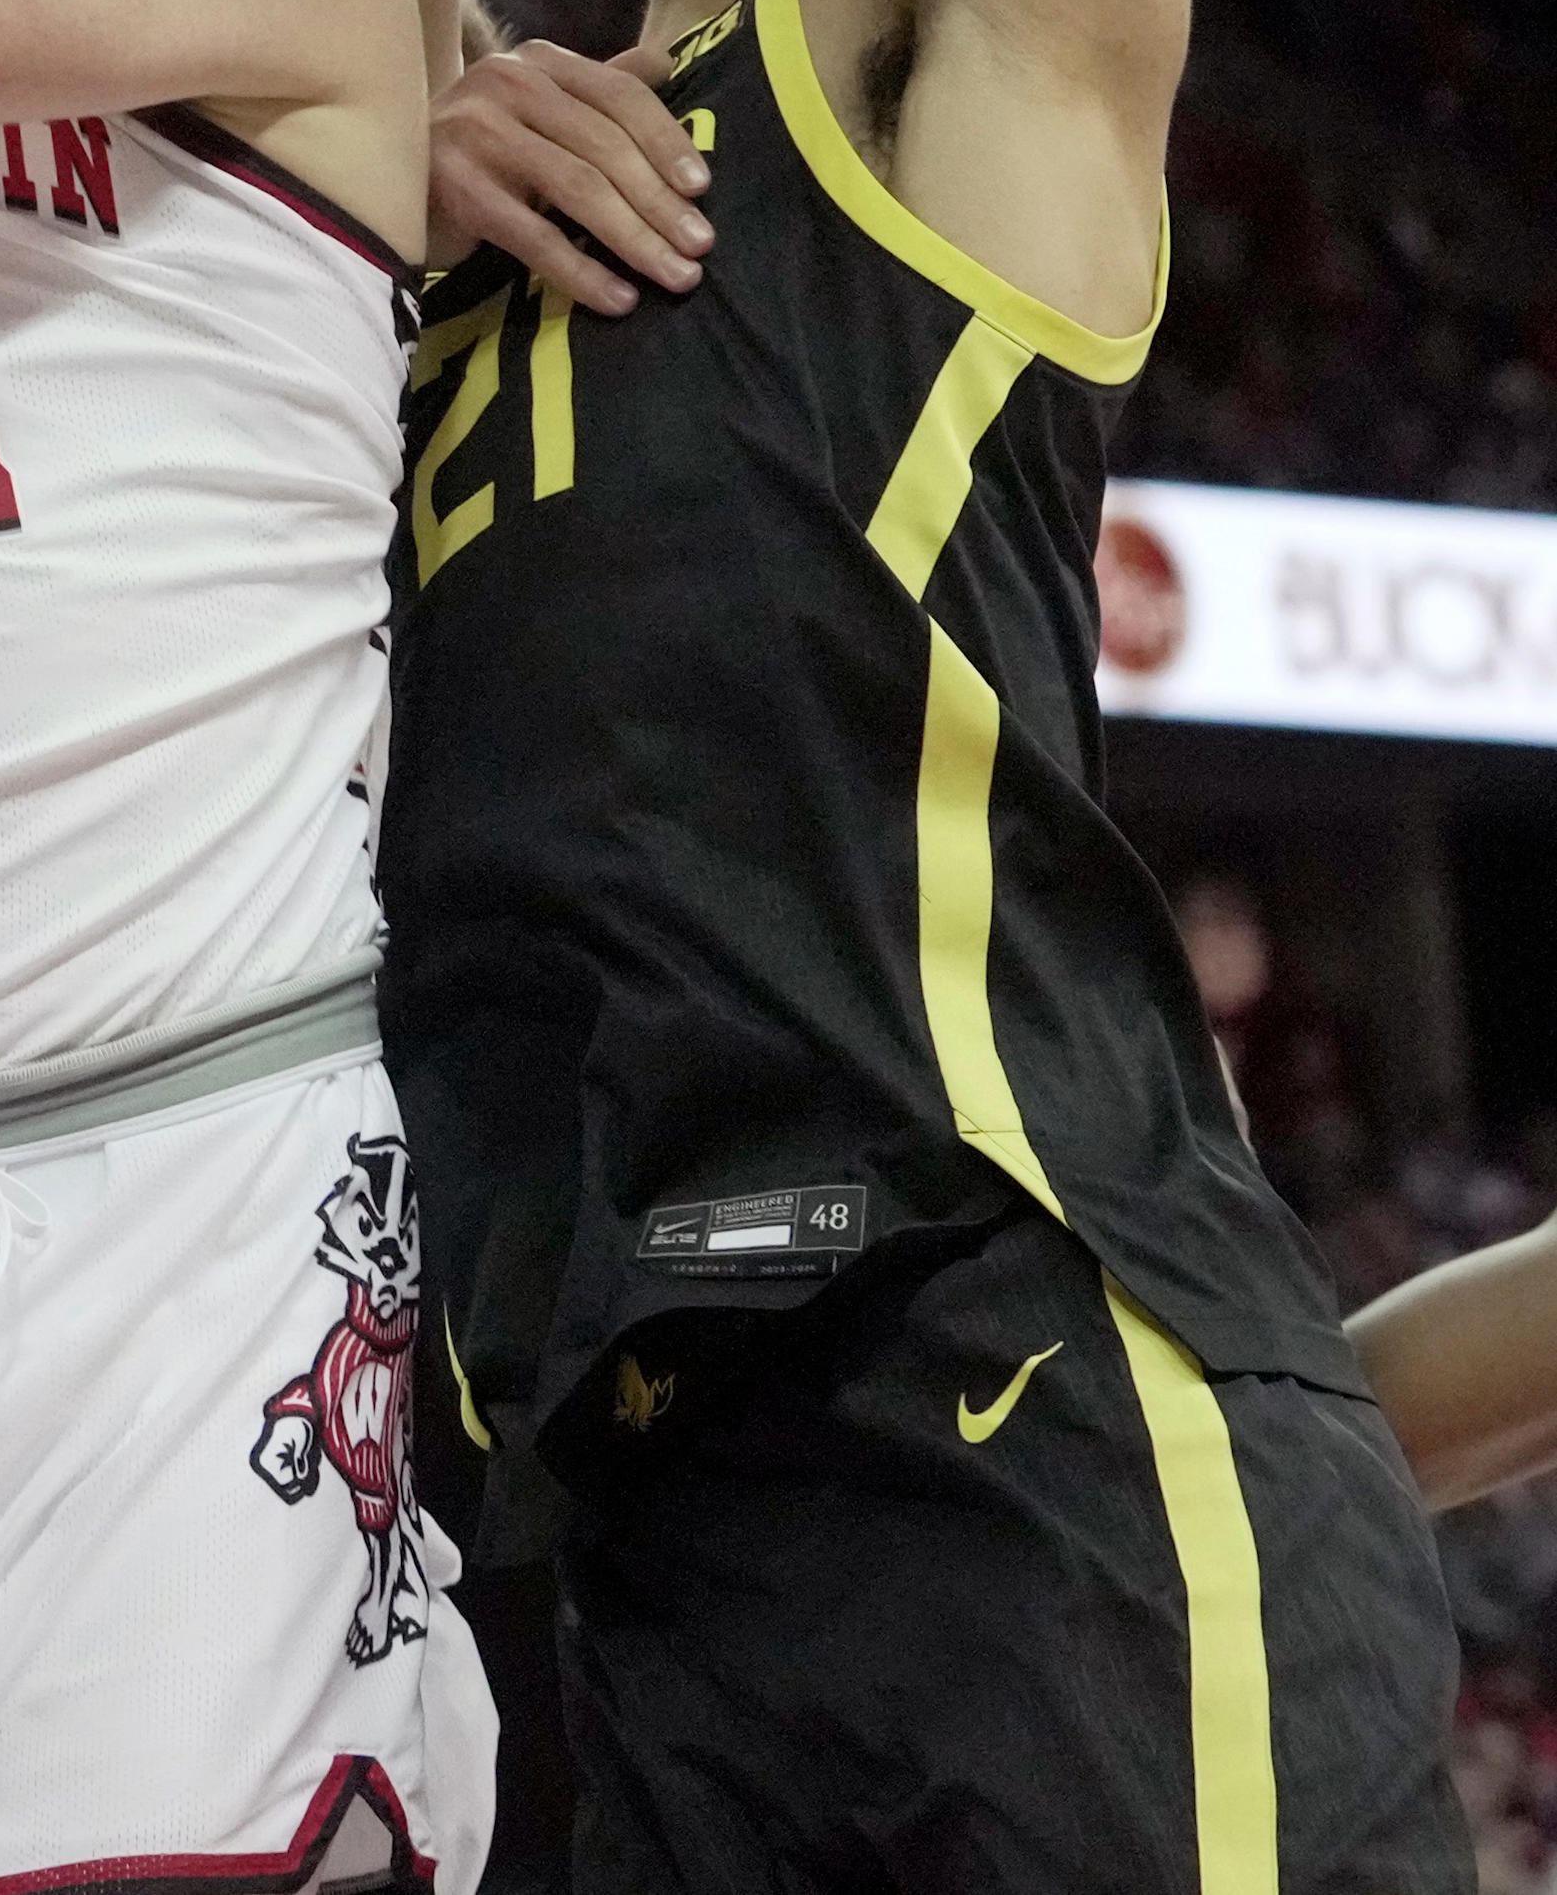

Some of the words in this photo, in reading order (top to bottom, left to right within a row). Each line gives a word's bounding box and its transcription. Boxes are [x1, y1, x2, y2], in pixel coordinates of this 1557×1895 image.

[411, 274, 575, 591] 21
[715, 1194, 794, 1216] ENGINEERED
[809, 1203, 849, 1230] 48
